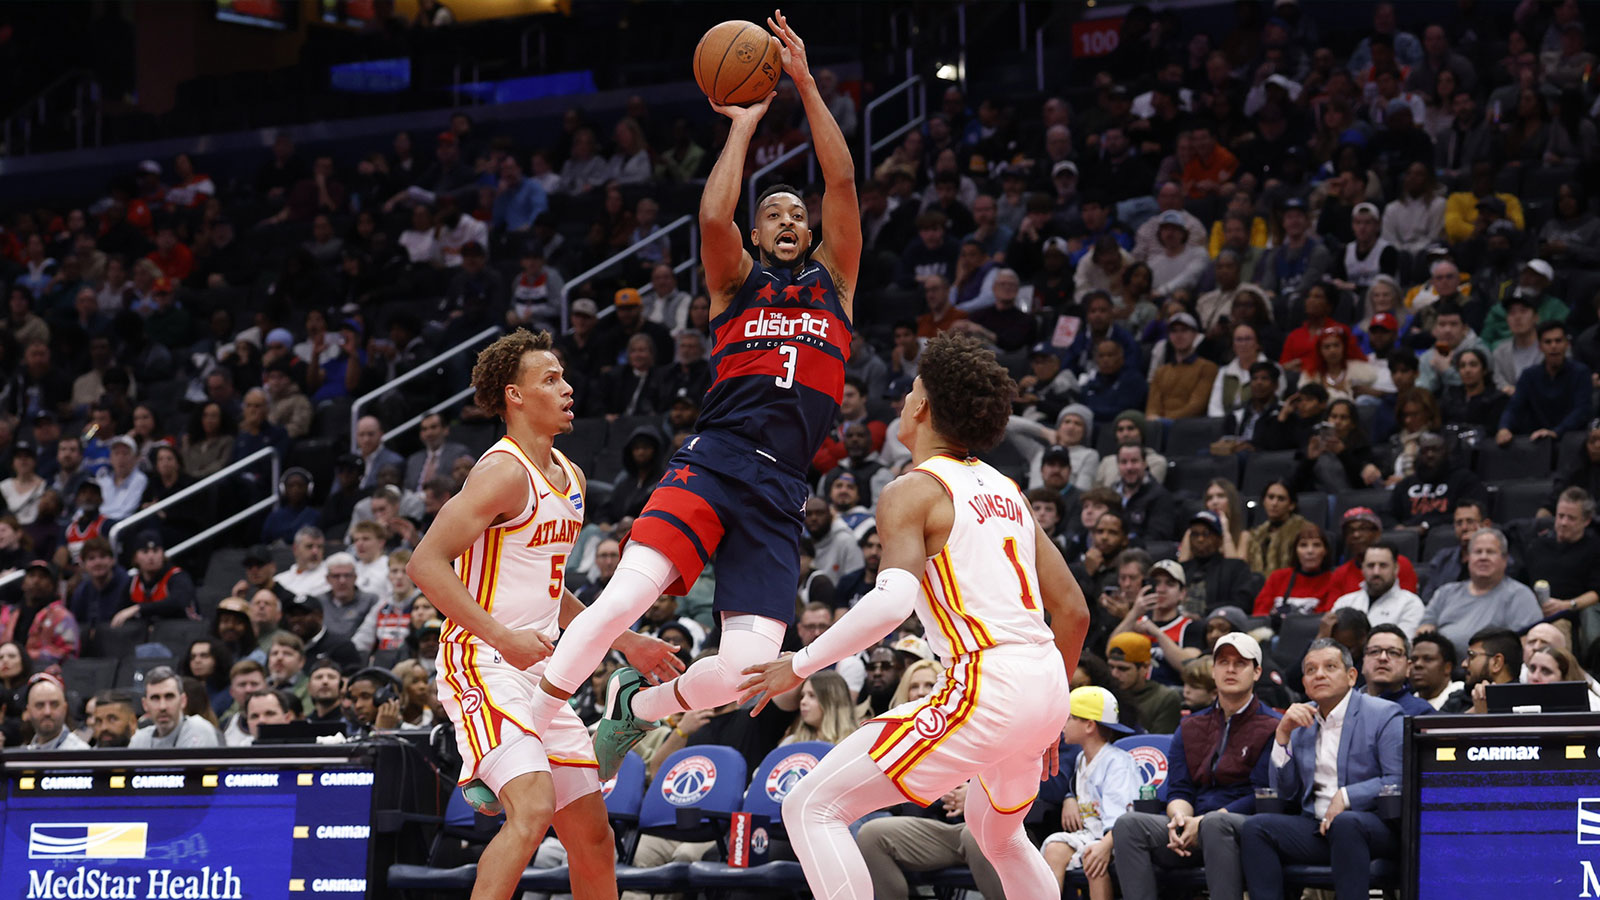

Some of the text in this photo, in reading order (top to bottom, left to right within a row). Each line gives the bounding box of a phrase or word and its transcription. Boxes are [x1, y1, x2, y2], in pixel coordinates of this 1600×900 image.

[1081, 29, 1118, 54] 100
[744, 308, 829, 338] district
[775, 344, 798, 389] 3
[968, 494, 1024, 527] JOHNSON
[526, 519, 582, 548] ATLANT
[548, 553, 566, 600] 5
[1002, 536, 1039, 611] 1
[734, 814, 745, 866] POPCORN
[26, 866, 242, 899] MedStar Health
